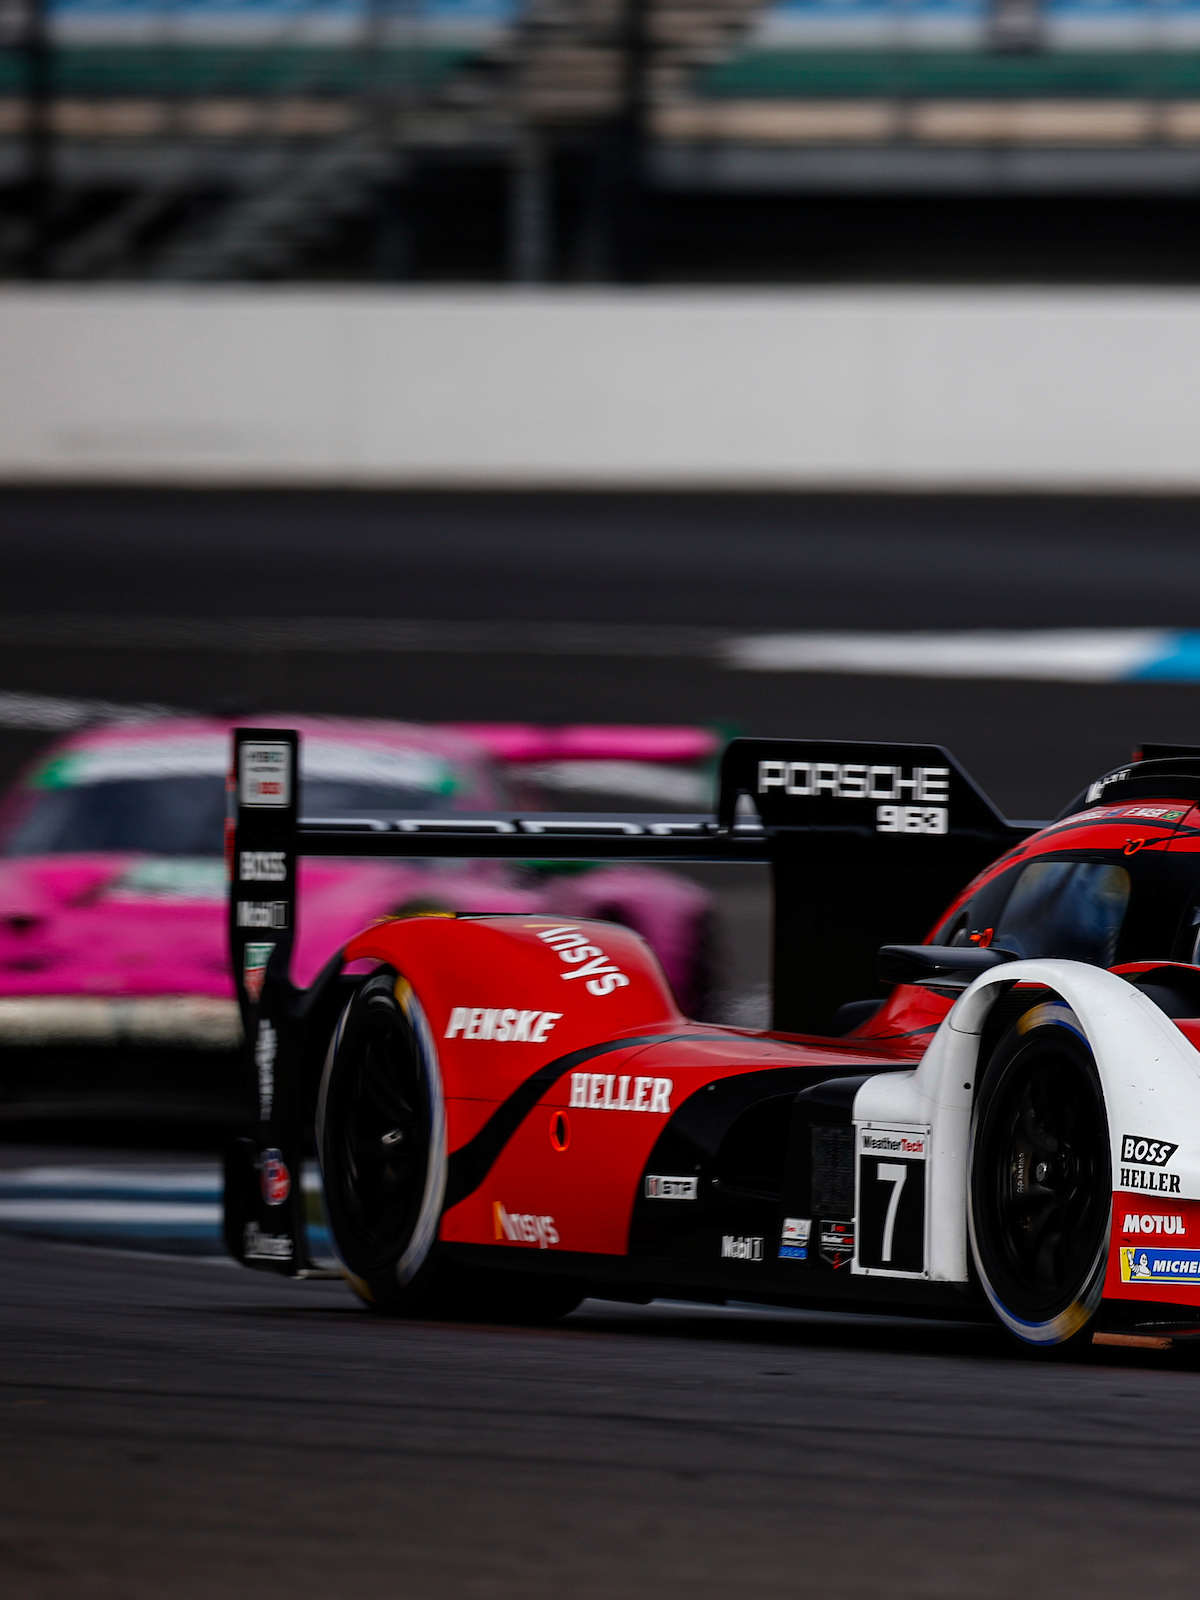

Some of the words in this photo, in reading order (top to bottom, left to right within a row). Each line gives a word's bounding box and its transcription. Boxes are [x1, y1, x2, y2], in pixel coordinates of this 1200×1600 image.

[758, 760, 949, 801] PORSCHE
[876, 805, 949, 834] 963
[443, 1007, 564, 1043] PENSKE
[568, 1072, 674, 1113] HELLER
[862, 1134, 924, 1153] WeatherTech
[1123, 1138, 1172, 1164] BOSS
[1120, 1168, 1181, 1193] HELLER
[877, 1162, 907, 1261] 7
[1122, 1214, 1186, 1235] MOTUL
